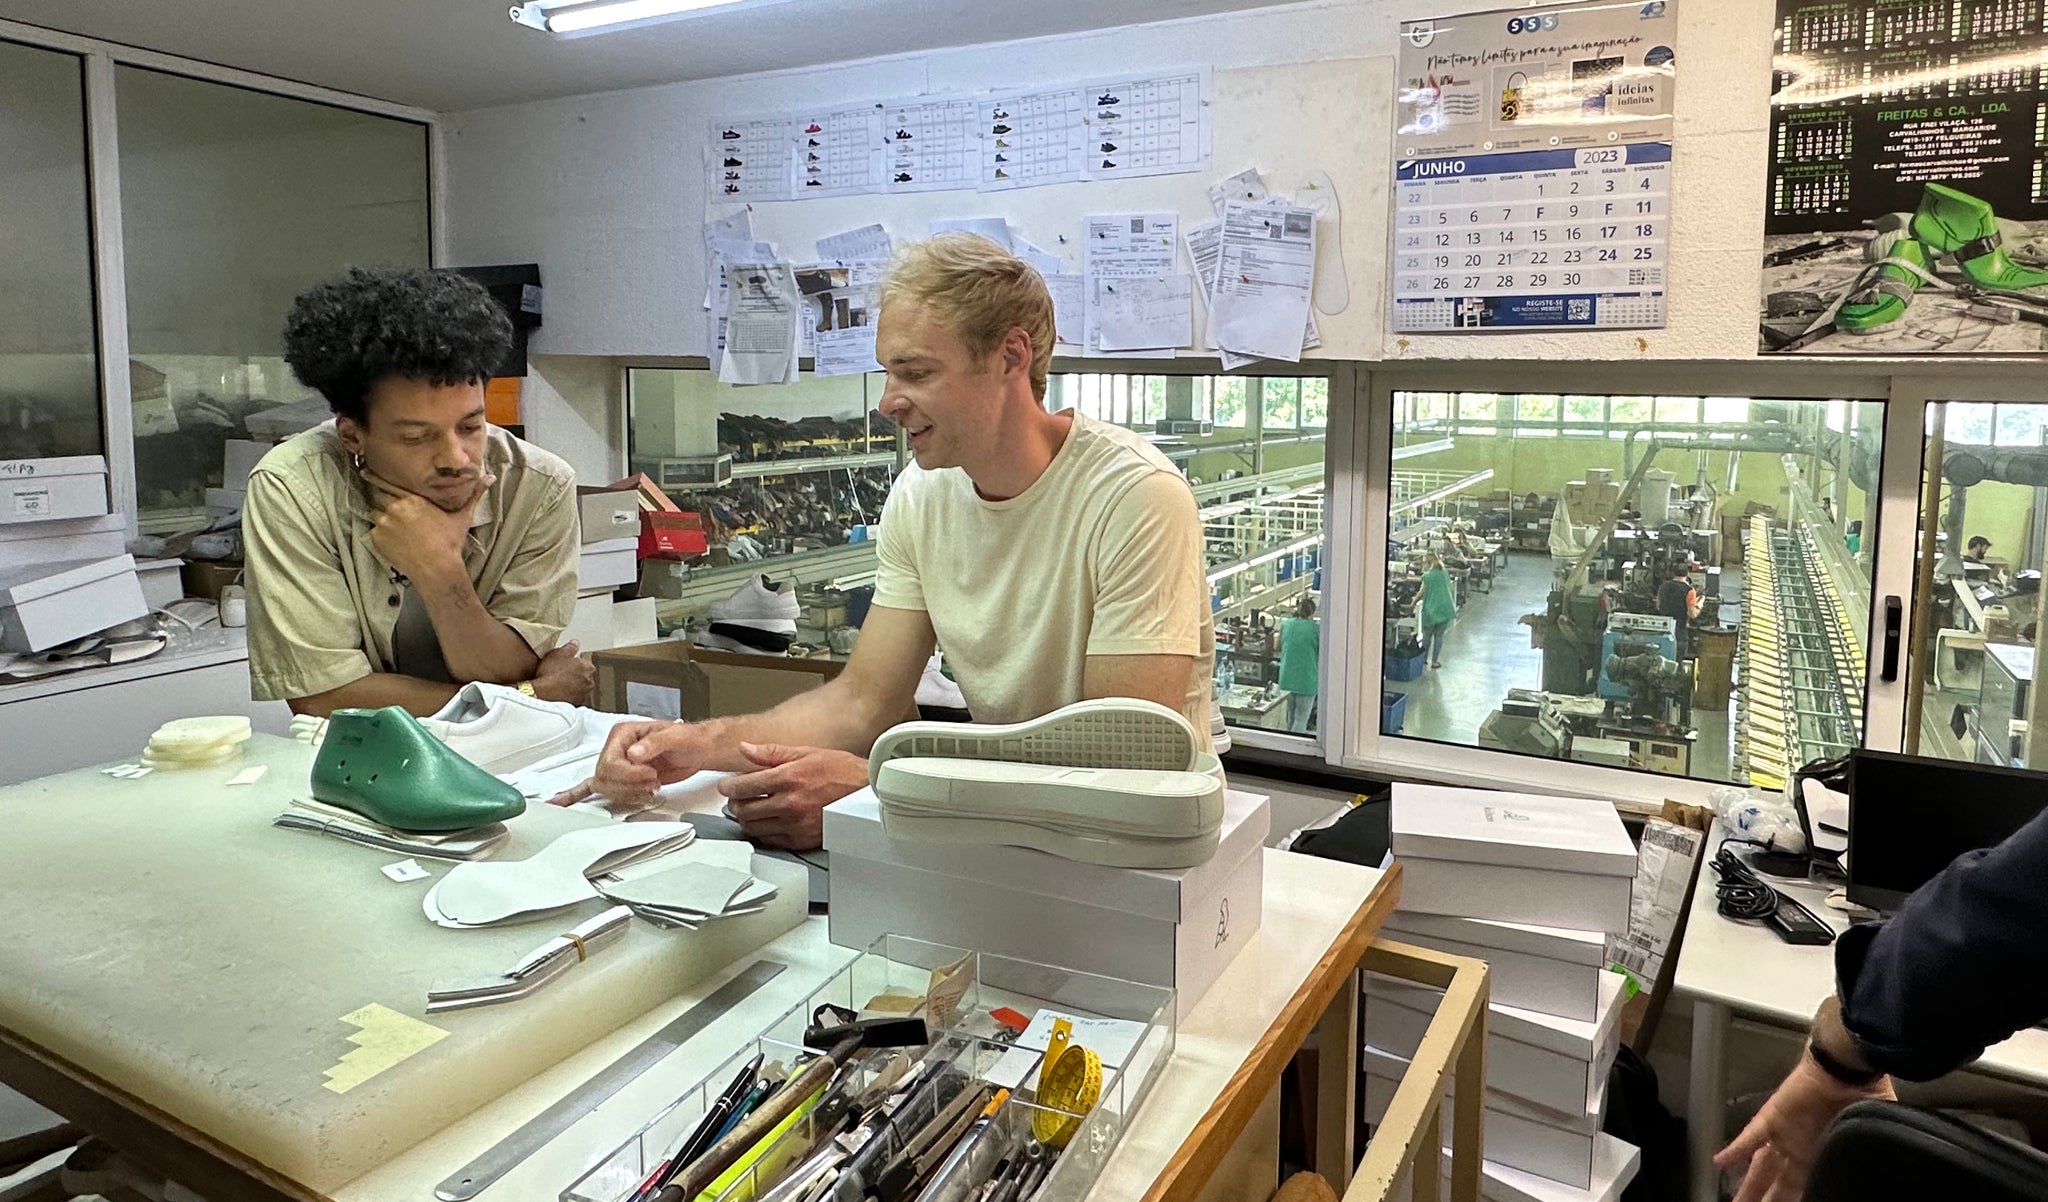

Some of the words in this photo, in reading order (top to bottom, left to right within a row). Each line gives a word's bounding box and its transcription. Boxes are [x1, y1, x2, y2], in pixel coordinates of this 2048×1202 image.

[1618, 84, 1654, 95] ideias
[1618, 97, 1654, 106] infinitas
[1877, 108, 1928, 121] FREITAS
[1933, 108, 1943, 117] &
[1981, 102, 2011, 114] LDA.
[1413, 160, 1466, 179] JUNHO
[1583, 150, 1618, 164] 2023
[1409, 194, 1420, 203] 22
[1538, 185, 1543, 195] 1
[1571, 182, 1578, 194] 2
[1606, 180, 1614, 192] 3
[1641, 178, 1649, 189] 4
[1408, 215, 1420, 224] 23
[1440, 213, 1446, 224] 5
[1470, 211, 1478, 222] 6
[1503, 209, 1511, 220] 7
[1570, 205, 1578, 217] 9
[1637, 201, 1650, 213] 11
[1407, 237, 1419, 246] 24
[1436, 234, 1449, 246] 12
[1467, 233, 1480, 244] 13
[1500, 231, 1513, 243] 14
[1533, 229, 1547, 241] 15
[1567, 228, 1581, 239] 16
[1601, 226, 1616, 238] 17
[1636, 225, 1652, 236] 18
[1407, 258, 1419, 267] 25
[1435, 256, 1448, 267] 19
[1465, 255, 1481, 266] 20
[1498, 253, 1511, 265] 21
[1531, 252, 1547, 264] 22
[1564, 251, 1581, 262] 23
[1599, 249, 1617, 261] 24
[1634, 248, 1652, 259] 25
[1406, 279, 1418, 289] 26
[1433, 278, 1448, 289] 26
[1464, 277, 1480, 288] 27
[1497, 275, 1513, 287] 28
[1530, 274, 1546, 286] 29
[1564, 273, 1580, 285] 30
